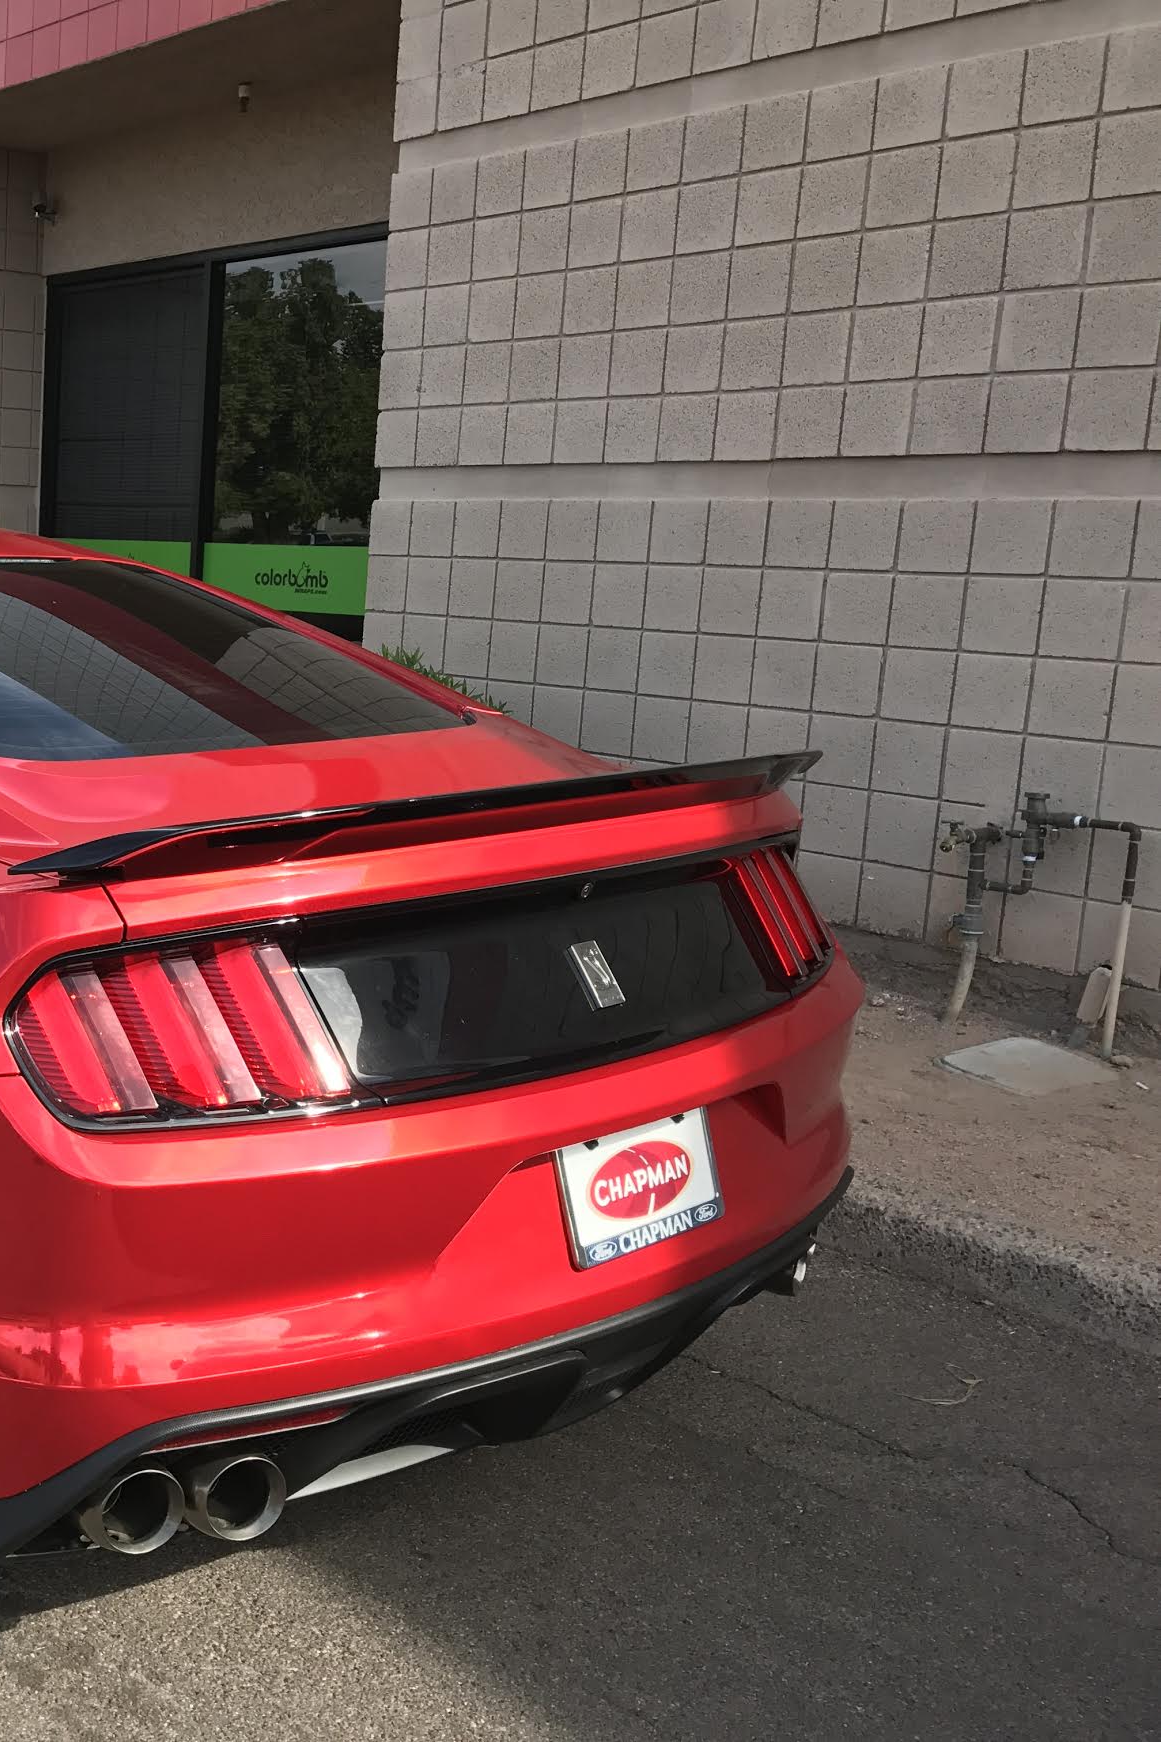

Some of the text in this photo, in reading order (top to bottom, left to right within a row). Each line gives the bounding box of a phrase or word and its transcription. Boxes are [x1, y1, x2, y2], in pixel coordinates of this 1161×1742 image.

[594, 1154, 688, 1206] CHAPMAN
[618, 1210, 693, 1253] CHAPMAN
[697, 1204, 716, 1220] Ford
